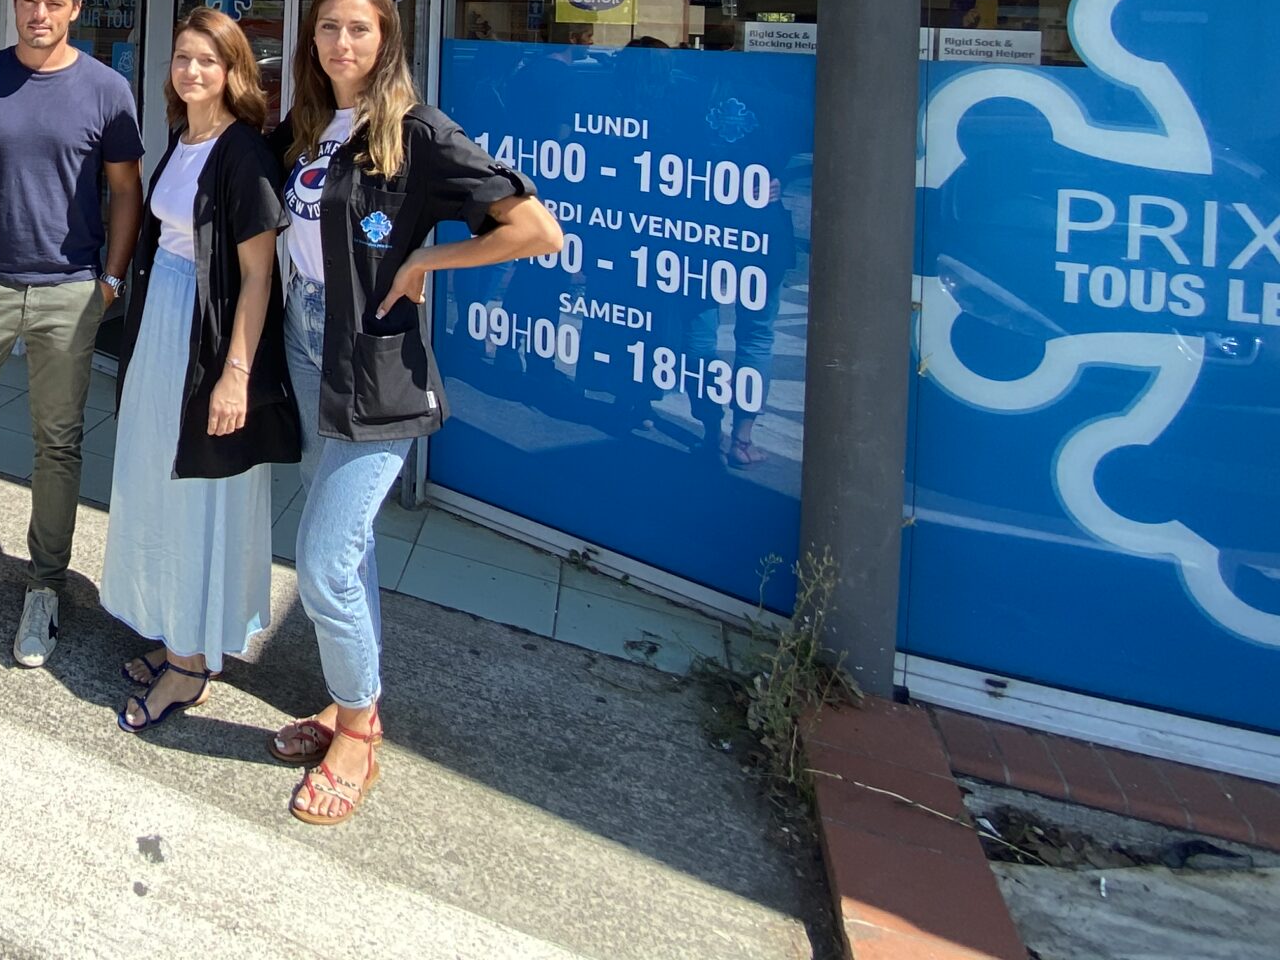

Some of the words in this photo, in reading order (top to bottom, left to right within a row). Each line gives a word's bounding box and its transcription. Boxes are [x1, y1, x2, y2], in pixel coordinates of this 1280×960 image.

[106, 10, 134, 28] TOU
[775, 31, 800, 40] Sock
[748, 39, 792, 51] Stocking
[794, 40, 817, 51] Help
[944, 36, 972, 48] Rigid
[974, 38, 1002, 48] Sock
[944, 47, 993, 58] Stocking
[995, 49, 1035, 60] Helper
[574, 113, 649, 139] LUNDI
[633, 150, 771, 209] 19H00
[285, 188, 305, 215] NEW
[544, 199, 582, 223] RDI
[588, 207, 622, 230] AU
[628, 212, 769, 255] VENDREDI
[1055, 188, 1280, 270] PRIX
[630, 245, 768, 311] 19H00
[1055, 260, 1206, 317] TOUS
[1226, 278, 1280, 327] LE
[558, 293, 652, 332] SAMEDI
[468, 302, 580, 365] 09H00
[626, 341, 763, 413] 18H30
